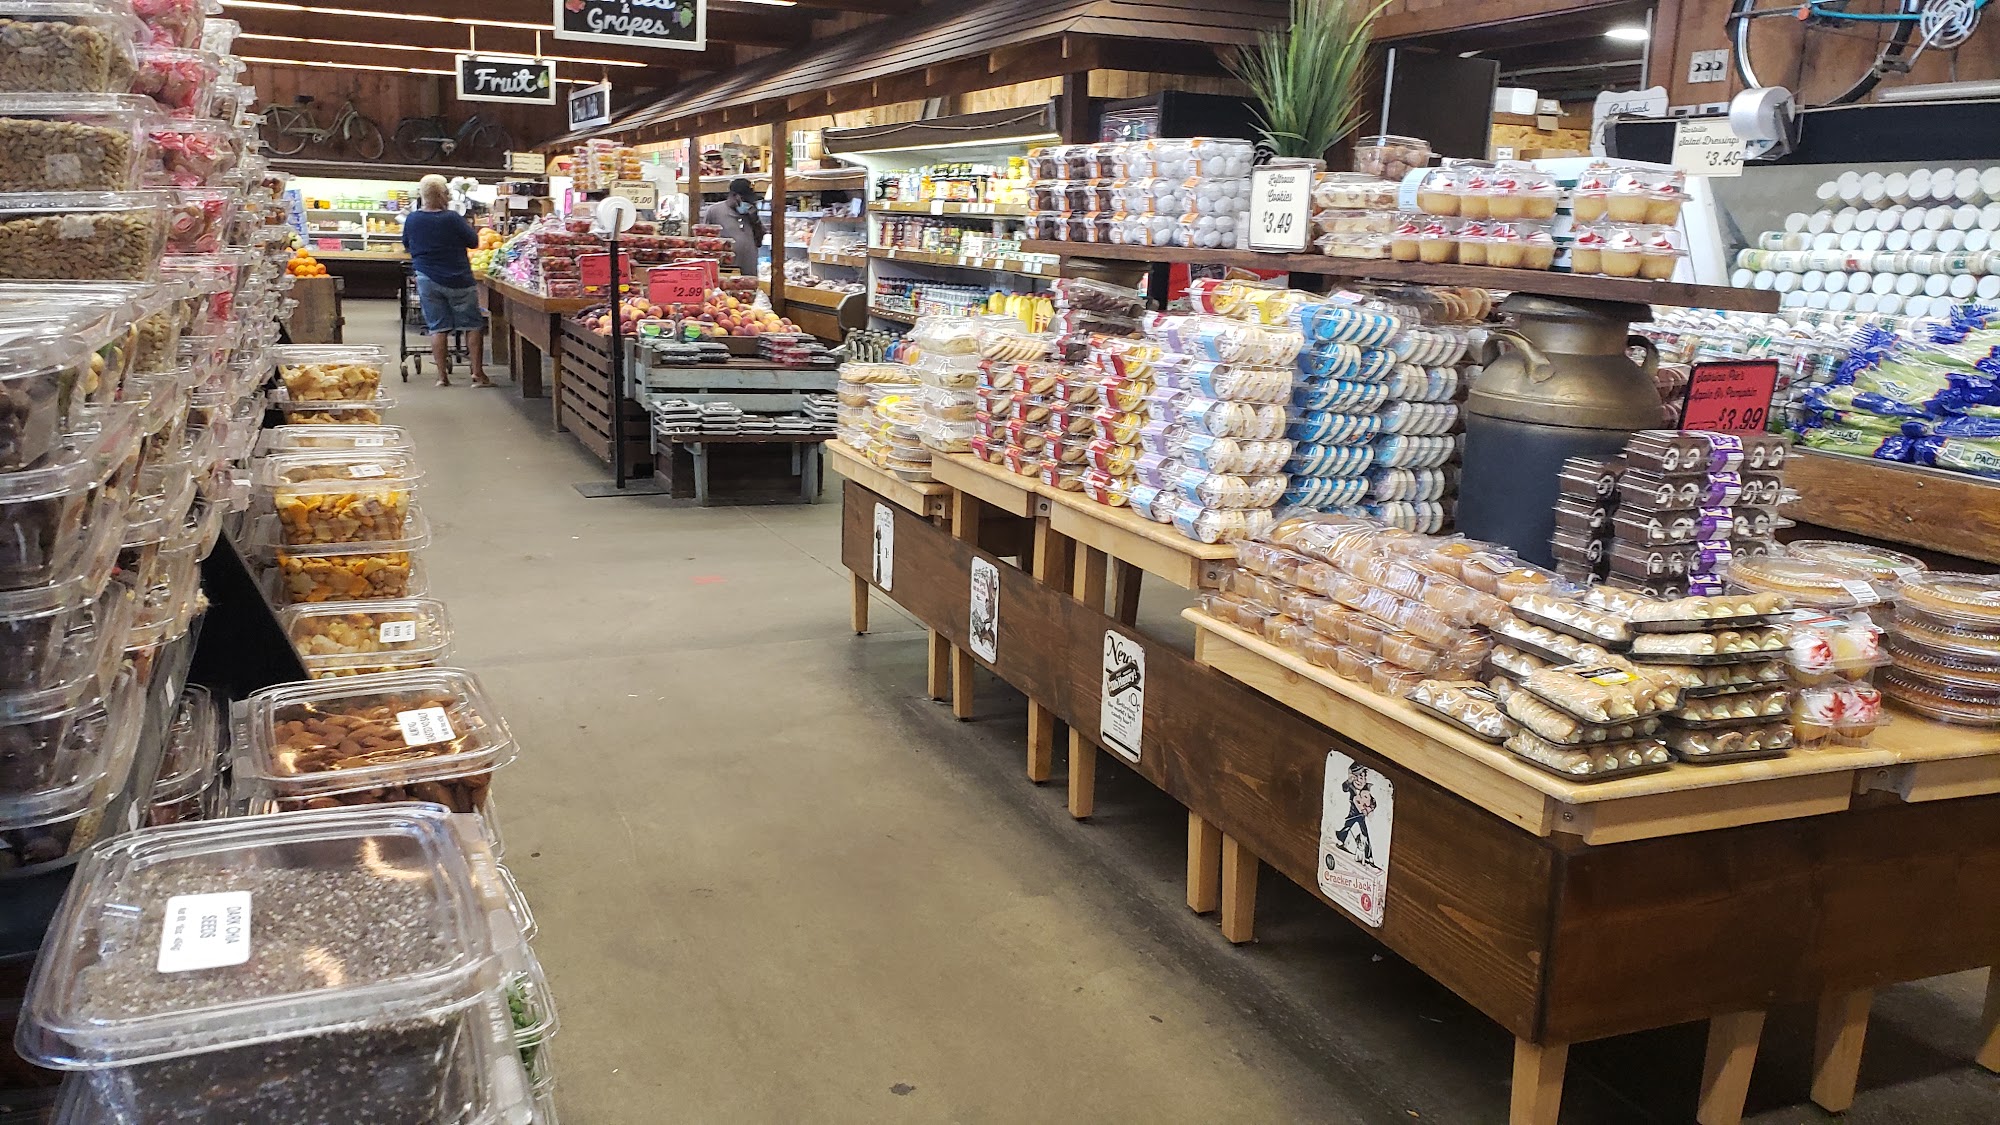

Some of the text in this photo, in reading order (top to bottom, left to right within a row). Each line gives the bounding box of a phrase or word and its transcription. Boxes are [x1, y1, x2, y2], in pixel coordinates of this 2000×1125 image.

[621, 3, 630, 13] &
[587, 7, 670, 36] Grapes
[474, 68, 538, 93] Fruit
[1679, 136, 1739, 147] Salad Dressings
[1268, 189, 1292, 202] Cookies
[1263, 211, 1293, 233] $3.49
[673, 286, 703, 297] $2.99
[1719, 408, 1763, 430] $3.99
[1324, 871, 1371, 892] Cracker Jack
[226, 906, 242, 925] DARK
[200, 915, 218, 938] SEEDS
